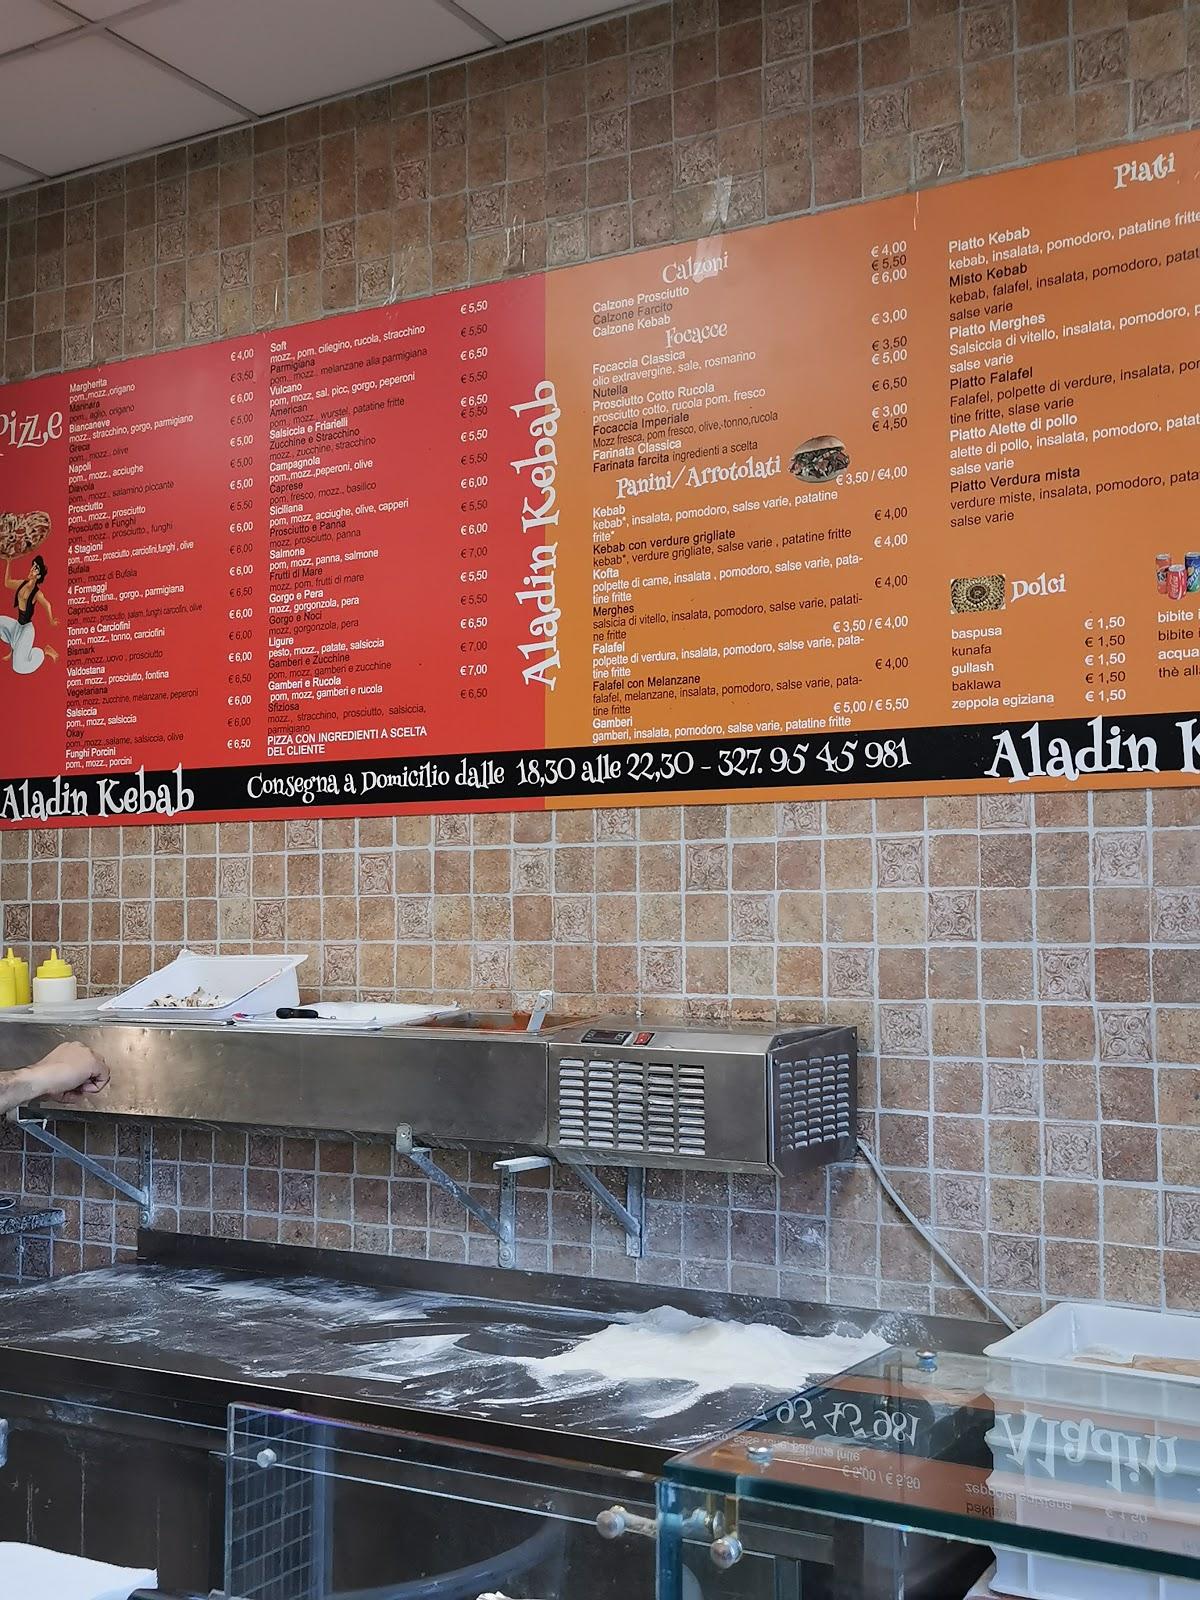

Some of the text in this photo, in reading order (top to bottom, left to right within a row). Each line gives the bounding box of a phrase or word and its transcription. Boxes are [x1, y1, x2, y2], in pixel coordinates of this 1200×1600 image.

[1113, 152, 1176, 189] Piati
[948, 252, 988, 270] kebab,
[992, 244, 1042, 262] insalata,
[1046, 229, 1114, 254] pomodoro,
[1118, 217, 1170, 239] patatine
[949, 224, 1030, 252] Piatto Kebab
[871, 241, 906, 258] € 4,00
[662, 252, 729, 283] Calzoni
[949, 261, 1027, 287] Misto Kebab
[871, 268, 906, 285] € 6,00
[592, 287, 689, 314] Calzone Prosciutto
[592, 302, 672, 326] Calzone Farcito
[592, 314, 670, 338] Calzone Kebab
[949, 313, 1045, 339] Piatto Merghes
[949, 338, 1001, 357] Salsiccia
[1005, 334, 1016, 347] di
[1019, 329, 1058, 345] vitello,
[1062, 320, 1114, 337] insalata,
[1119, 306, 1190, 330] pomodoro,
[665, 322, 728, 349] Focacce
[270, 340, 286, 352] Soft
[592, 350, 685, 375] Focaccia Classica
[949, 353, 1013, 374] salse varie
[950, 366, 1032, 390] Piatto Falafel
[269, 383, 302, 396] Vulcano
[592, 384, 628, 399] Nutella
[592, 383, 714, 412] Prosciutto Cotto Rucola
[871, 404, 907, 419] € 3,00
[950, 396, 1074, 425] tine fritte, slase varie
[69, 419, 110, 432] Biancaneve
[592, 412, 689, 436] Focaccia Imperiale
[949, 413, 1077, 442] Piatto Alette di pollo
[592, 440, 681, 461] Farinata Classica
[68, 462, 91, 474] Napoli
[269, 455, 320, 472] Campagnola
[950, 467, 1080, 493] Piatto Verdura mista
[68, 502, 103, 514] Prosciutto
[269, 504, 303, 515] Siciliana
[592, 504, 625, 518] Kebab
[874, 507, 907, 521] € 4,00
[509, 380, 562, 691] Aladin Kebab
[592, 530, 735, 555] Kebab con verdure grigliate
[68, 542, 102, 554] 4 Stagioni
[269, 548, 305, 559] Salmone
[592, 568, 619, 580] Kofta
[67, 581, 107, 595] 4 Formaggi
[1010, 572, 1067, 602] Dolci
[269, 589, 323, 603] Gorgo e Pera
[592, 604, 634, 618] Merghes
[1157, 610, 1193, 623] bibite
[67, 626, 88, 635] Tonno
[96, 620, 130, 632] Carciofini
[1084, 616, 1125, 630] € 1,50
[951, 627, 1002, 640] baspusa
[1084, 634, 1125, 647] € 1,50
[1158, 628, 1193, 641] bibite
[268, 636, 294, 648] Ligure
[592, 641, 625, 654] Falafel
[951, 644, 991, 657] kunafa
[1158, 648, 1199, 661] acqua
[1084, 652, 1125, 666] € 1,50
[66, 666, 105, 676] Valdostana
[951, 661, 994, 677] gullash
[1182, 664, 1200, 676] all
[268, 675, 341, 690] Gamberi e Rucola
[592, 676, 700, 691] Falafel con Melanzane
[951, 679, 1001, 691] baklawa
[1085, 671, 1125, 684] € 1,50
[951, 693, 1054, 710] zeppola egiziana
[1084, 689, 1126, 702] € 1,50
[592, 716, 632, 729] Gamberi
[267, 726, 427, 745] PIZZA CON INGREDIENTI A SCELTA
[65, 746, 115, 759] Funghi Porcini
[267, 744, 325, 756] DEL CLIENTE
[983, 714, 1160, 783] Aladin
[247, 737, 913, 804] Consegna a Domicilio dalle 18,30 alle 22,30 327. 95 45 981
[0, 762, 195, 822] Aladin Kebab
